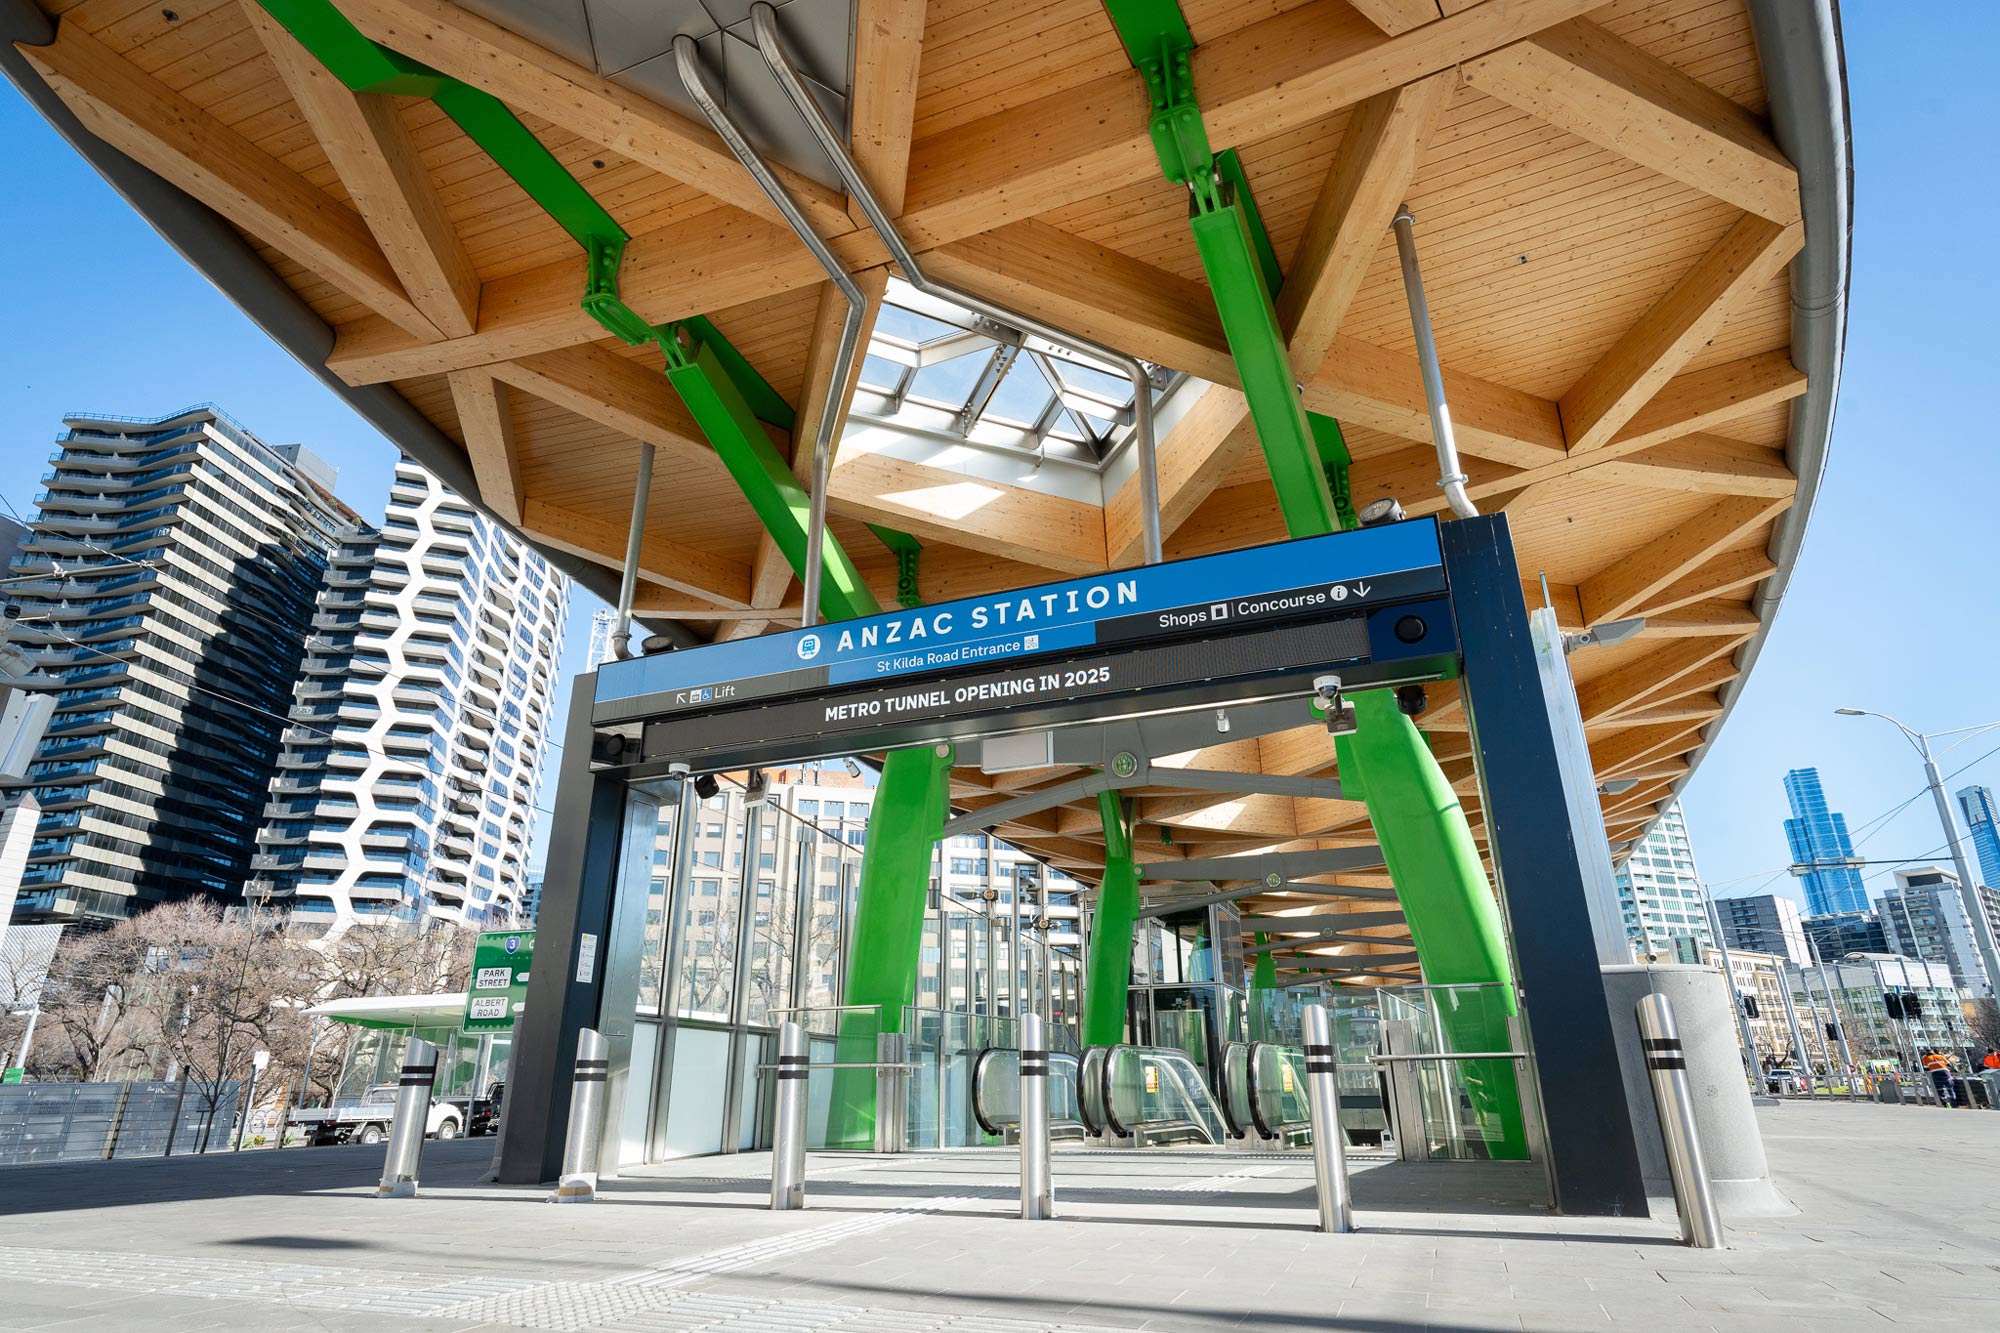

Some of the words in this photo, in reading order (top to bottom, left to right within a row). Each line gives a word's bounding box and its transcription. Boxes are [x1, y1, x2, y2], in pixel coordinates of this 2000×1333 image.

[1159, 609, 1207, 628] Shops
[1238, 591, 1326, 615] Concourse
[836, 612, 954, 653] ANZAC
[970, 579, 1138, 630] STATION
[877, 659, 891, 673] St
[893, 654, 924, 671] Kilda
[927, 649, 959, 665] Road
[961, 639, 1021, 659] Entrance
[714, 685, 736, 699] Lift
[825, 700, 881, 722] METRO
[884, 690, 950, 712] TUNNEL
[954, 678, 1035, 703] OPENING
[1039, 674, 1060, 690] IN
[1063, 666, 1110, 687] 2025
[509, 939, 516, 949] 3
[484, 969, 505, 977] PARK
[478, 979, 508, 987] STREET
[474, 998, 506, 1007] ALBERT
[477, 1009, 500, 1017] ROAD
